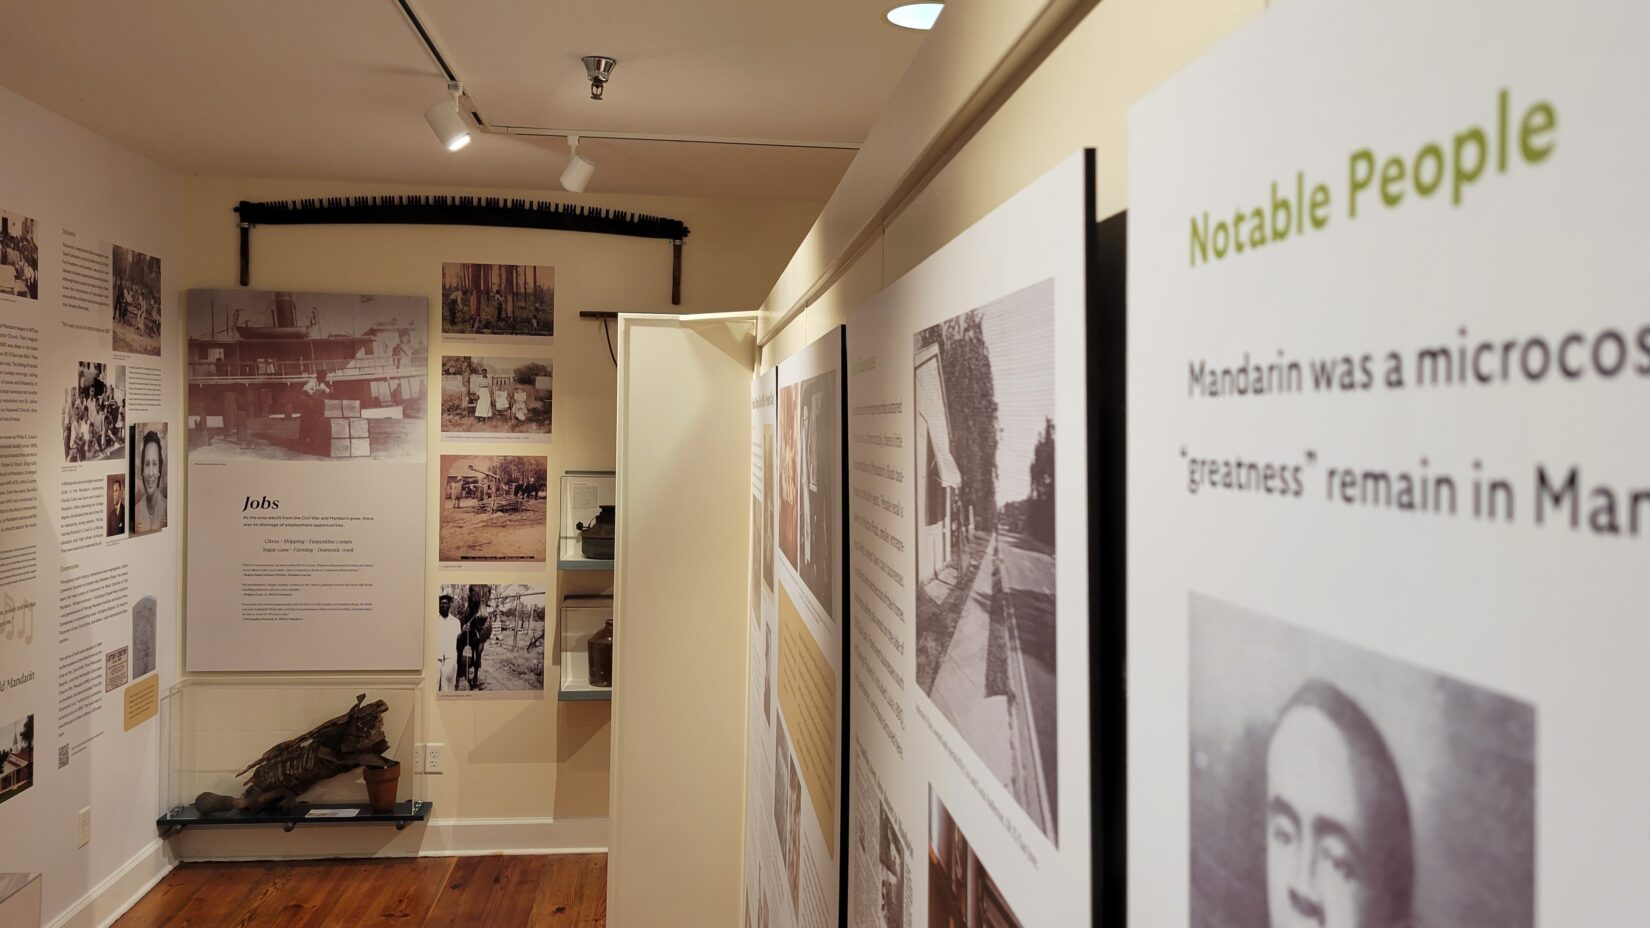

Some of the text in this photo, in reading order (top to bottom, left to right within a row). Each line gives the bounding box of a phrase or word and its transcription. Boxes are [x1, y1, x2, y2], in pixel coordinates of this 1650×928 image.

[1190, 87, 1557, 267] Notable People
[1188, 350, 1302, 398] Mandarin
[1309, 353, 1374, 391] was
[1385, 350, 1404, 389] a
[242, 496, 280, 512] Jobs
[1327, 457, 1457, 516] remain
[1473, 459, 1515, 522] in
[7, 670, 35, 689] Mandarin
